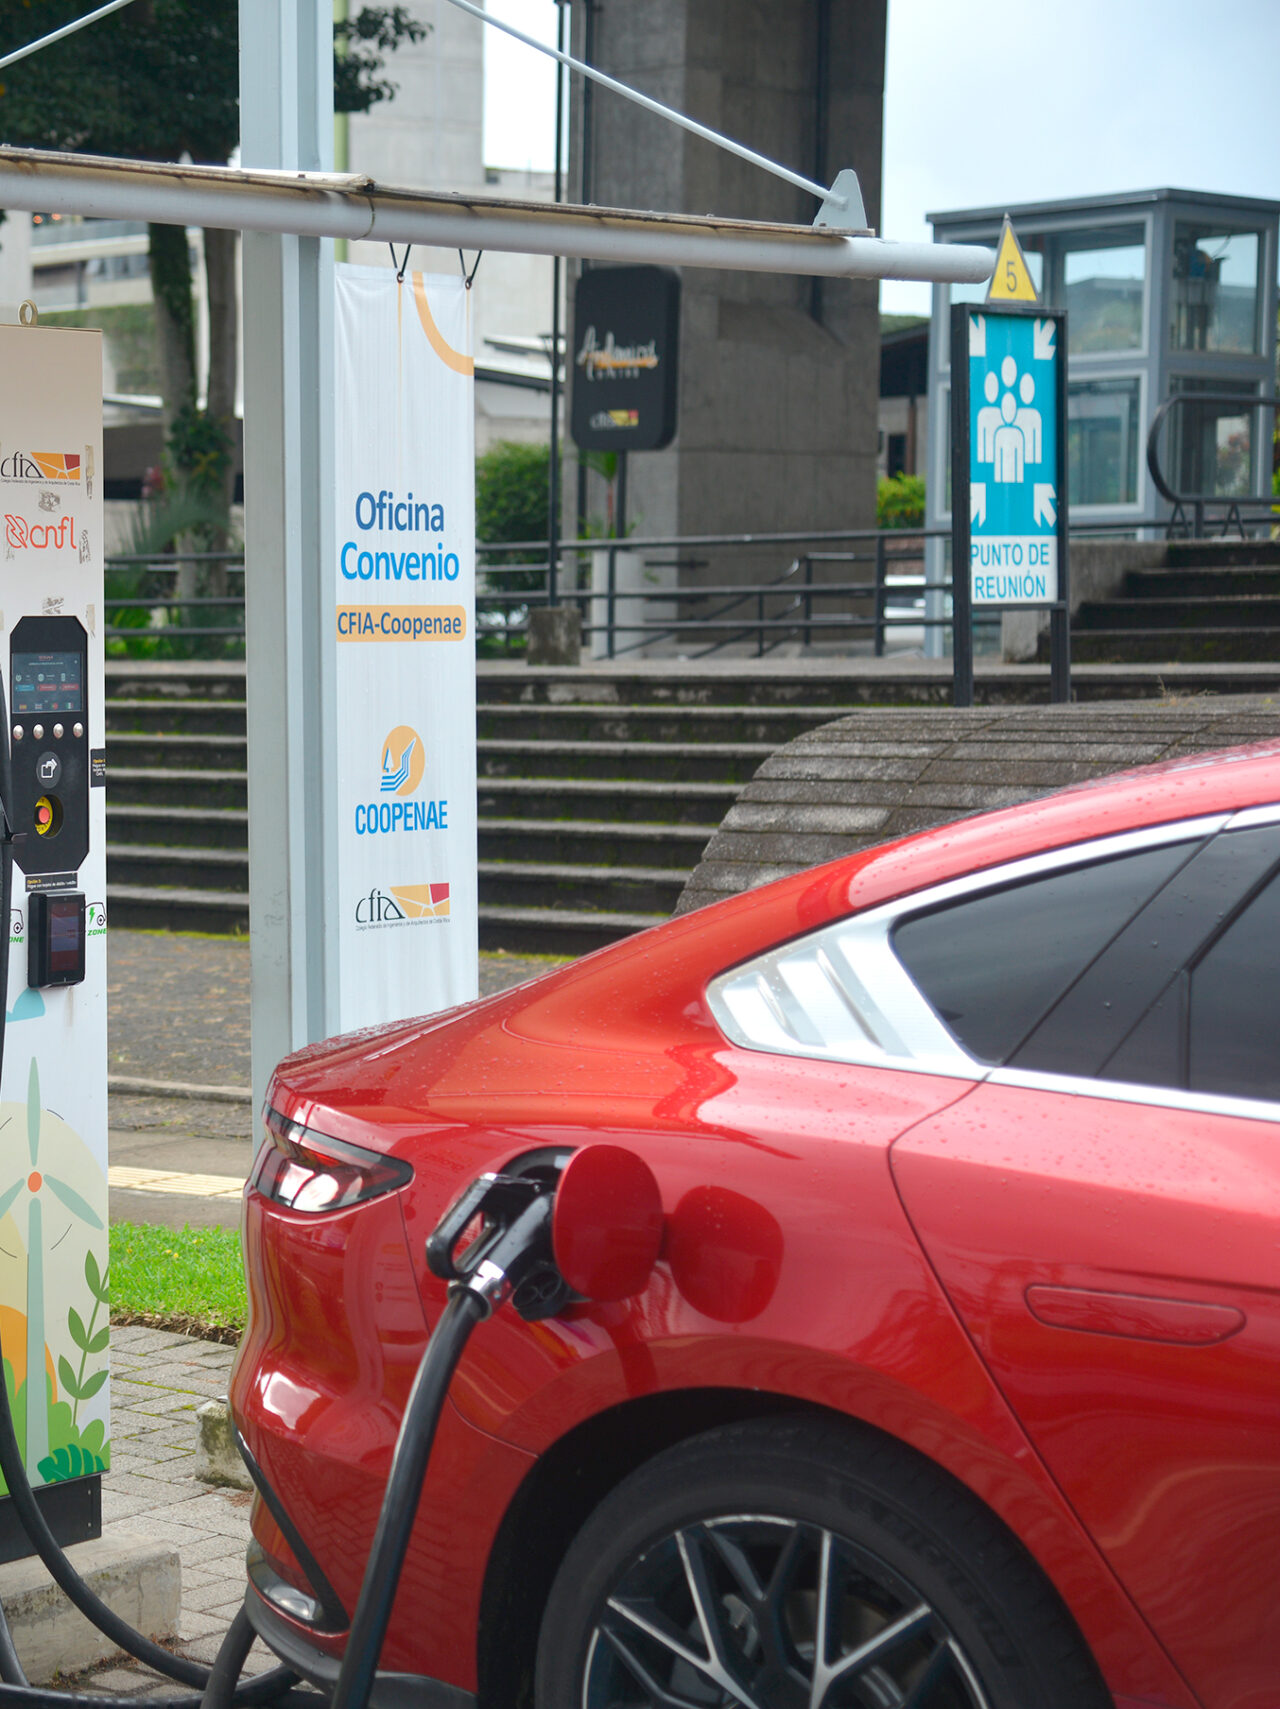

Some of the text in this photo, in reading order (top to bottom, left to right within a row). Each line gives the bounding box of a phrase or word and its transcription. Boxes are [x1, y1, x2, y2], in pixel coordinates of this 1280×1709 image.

[1006, 260, 1018, 292] 5
[355, 490, 445, 531] Oficina
[29, 516, 78, 550] cnfl
[340, 541, 460, 582] Convenio
[971, 543, 1050, 567] PUNTO DE
[975, 570, 1046, 599] REUNIÓN
[337, 611, 462, 639] CFIA-Coopenae
[355, 800, 449, 834] COOPENAE
[356, 888, 406, 923] cfia
[9, 936, 25, 944] ONE
[87, 928, 107, 937] ZONE
